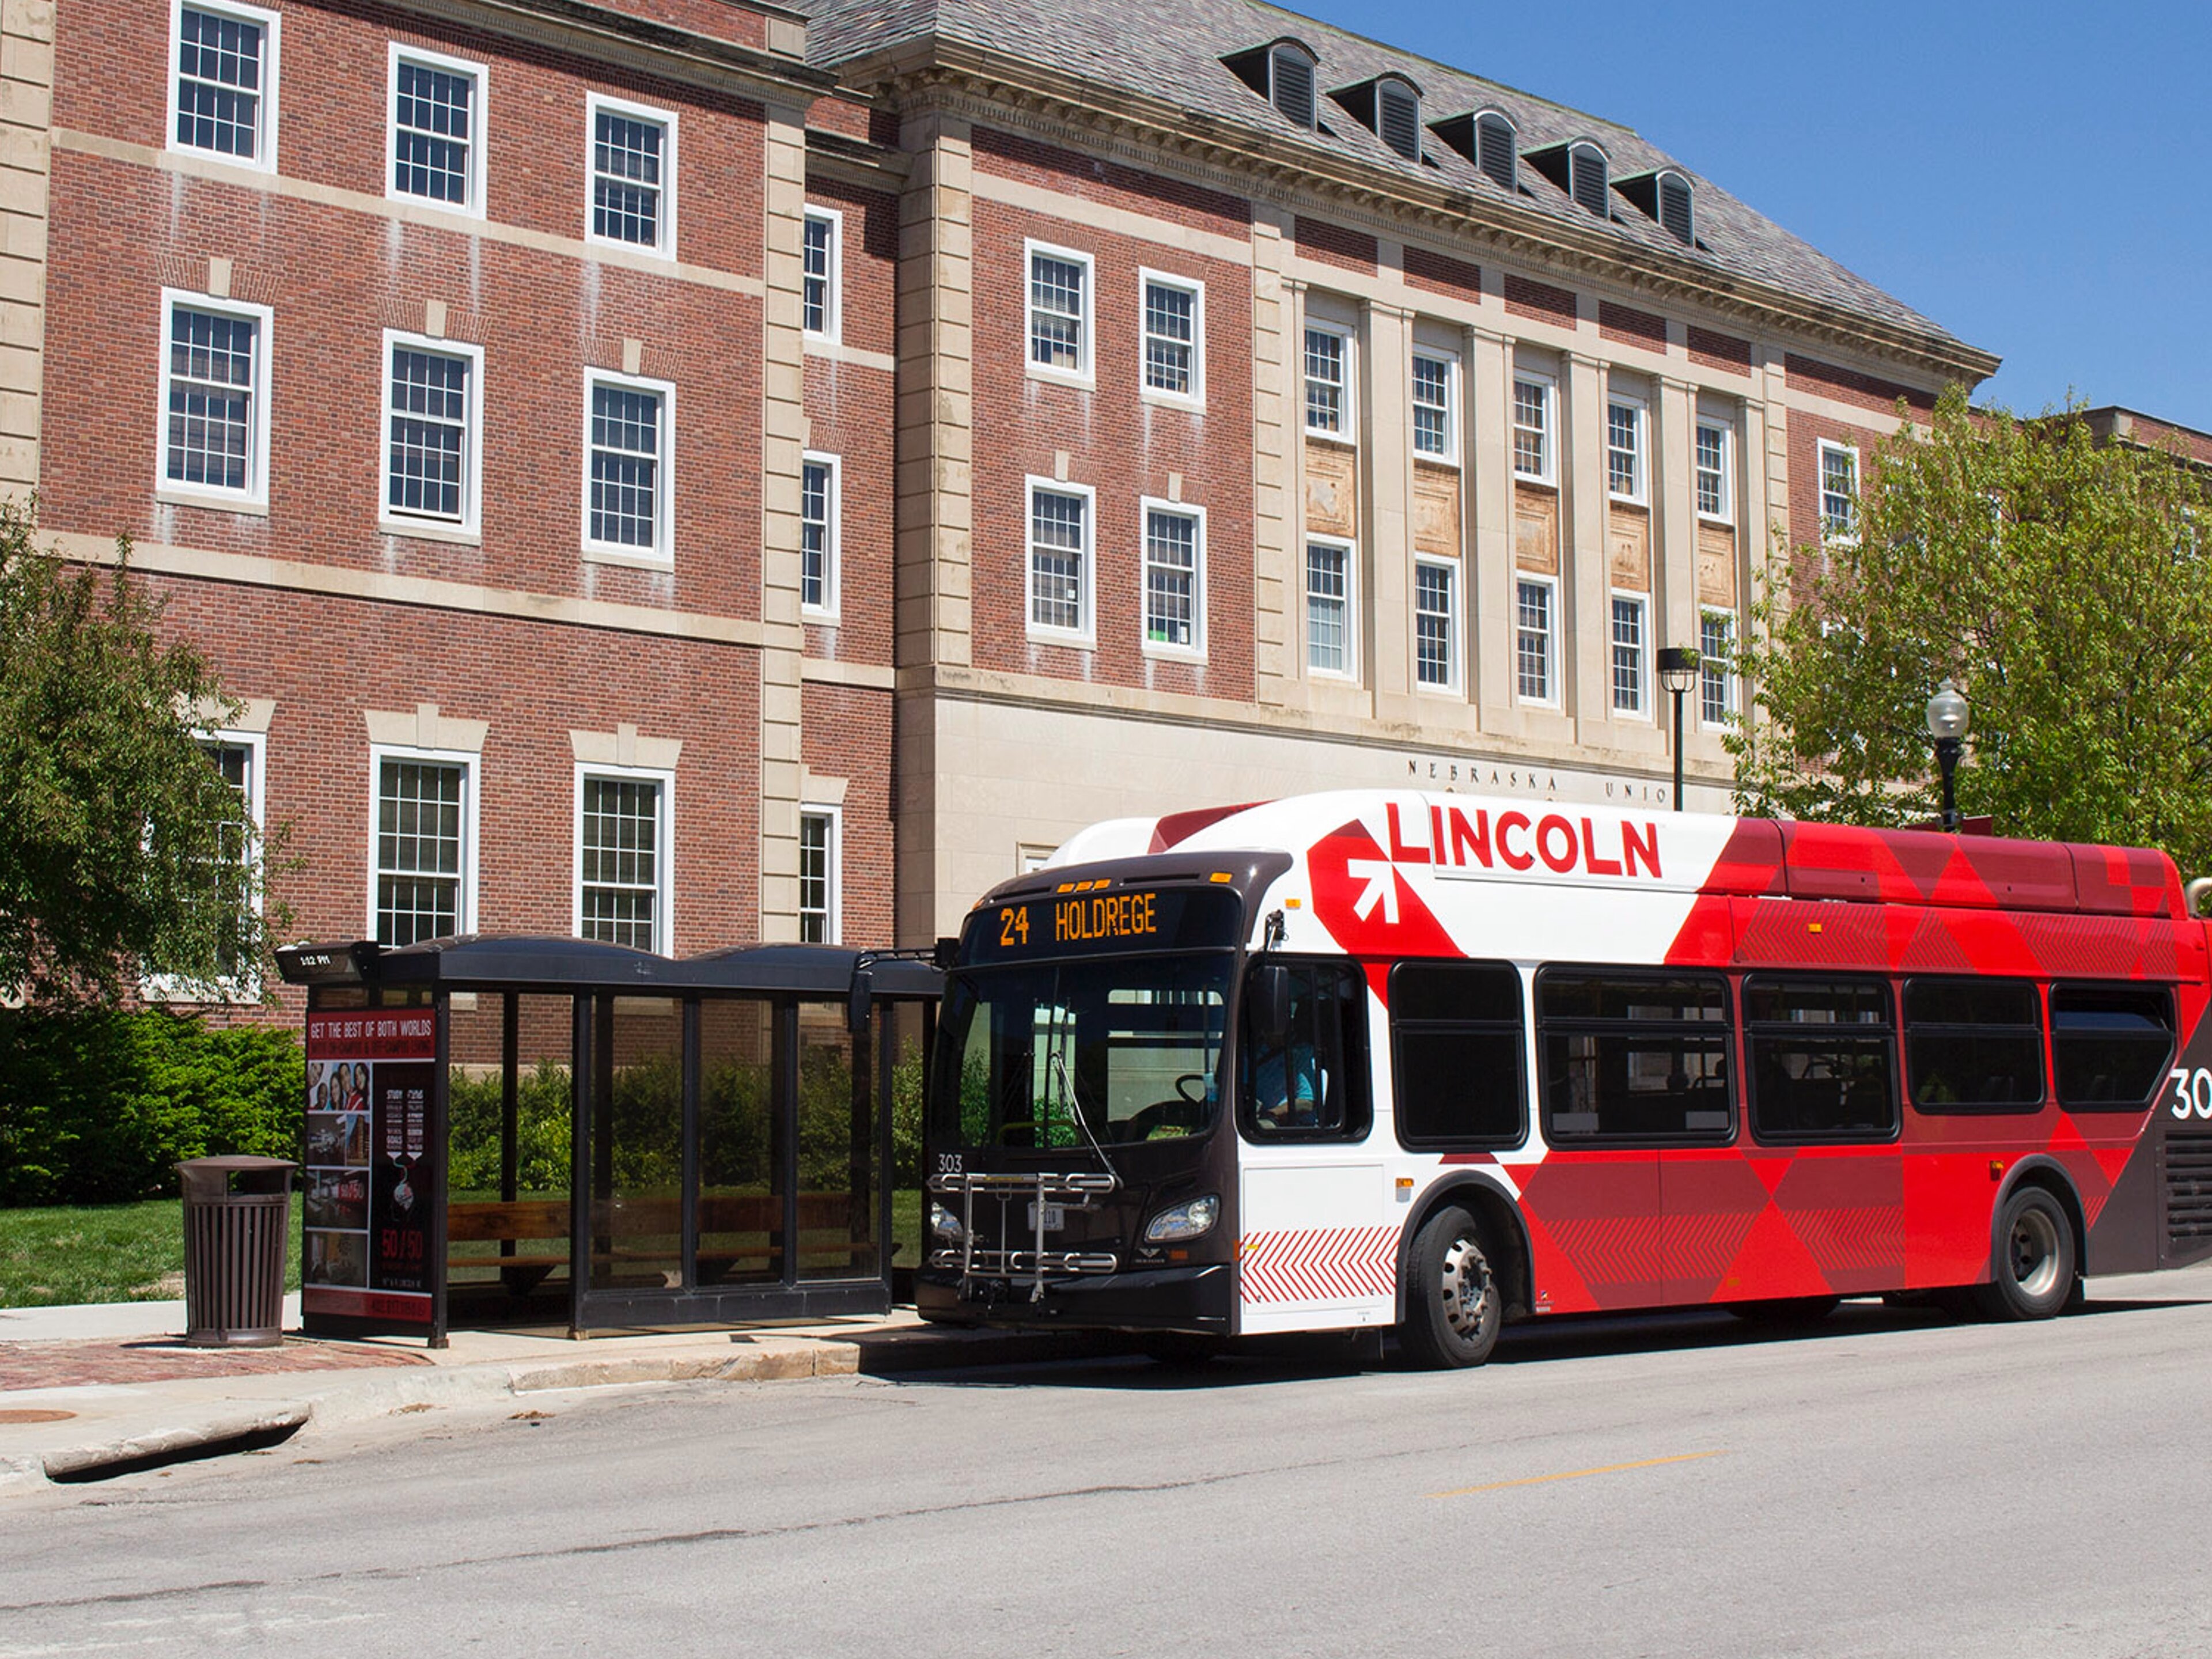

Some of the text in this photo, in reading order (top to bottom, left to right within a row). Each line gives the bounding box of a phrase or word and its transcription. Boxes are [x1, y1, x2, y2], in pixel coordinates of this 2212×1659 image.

[1408, 760, 1666, 804] NEBRASKA UNIO
[1386, 803, 1662, 878] LINCOLN
[1000, 893, 1156, 946] 24 HOLDREGE
[311, 1020, 431, 1039] GET THE BEST OF BOTH WORLDS
[938, 1154, 962, 1173] 303
